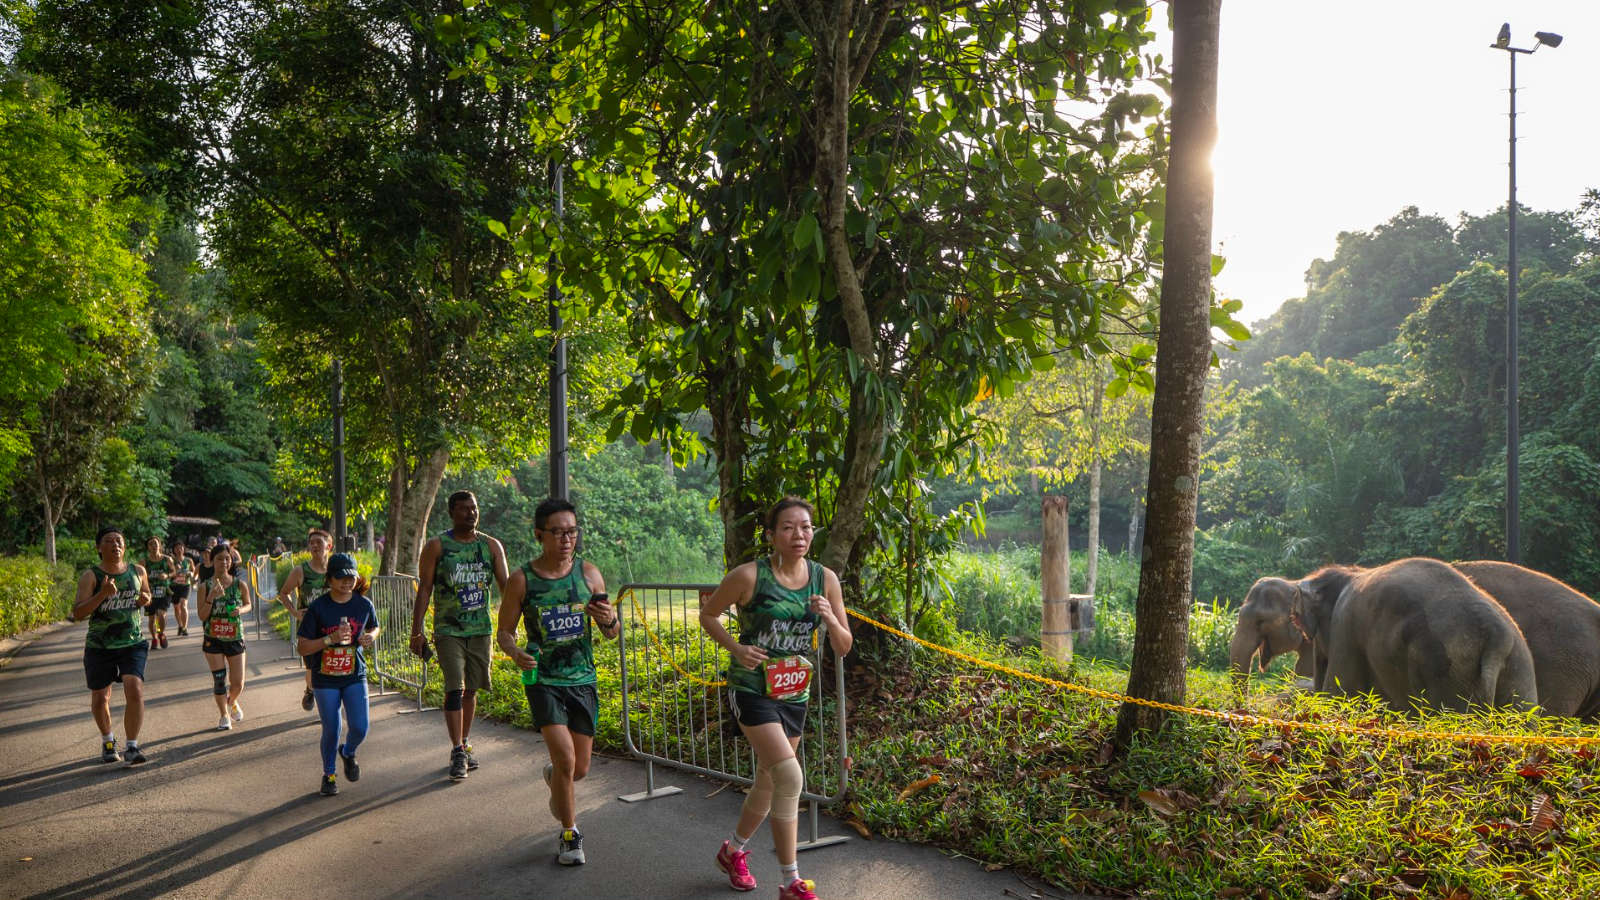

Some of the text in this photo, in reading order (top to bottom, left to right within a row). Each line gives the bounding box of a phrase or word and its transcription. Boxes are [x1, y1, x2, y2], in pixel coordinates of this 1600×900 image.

[462, 591, 483, 603] 1497
[548, 615, 581, 631] 1203
[771, 619, 813, 634] RUN FOR
[326, 657, 351, 667] 2575
[774, 670, 807, 688] 2309
